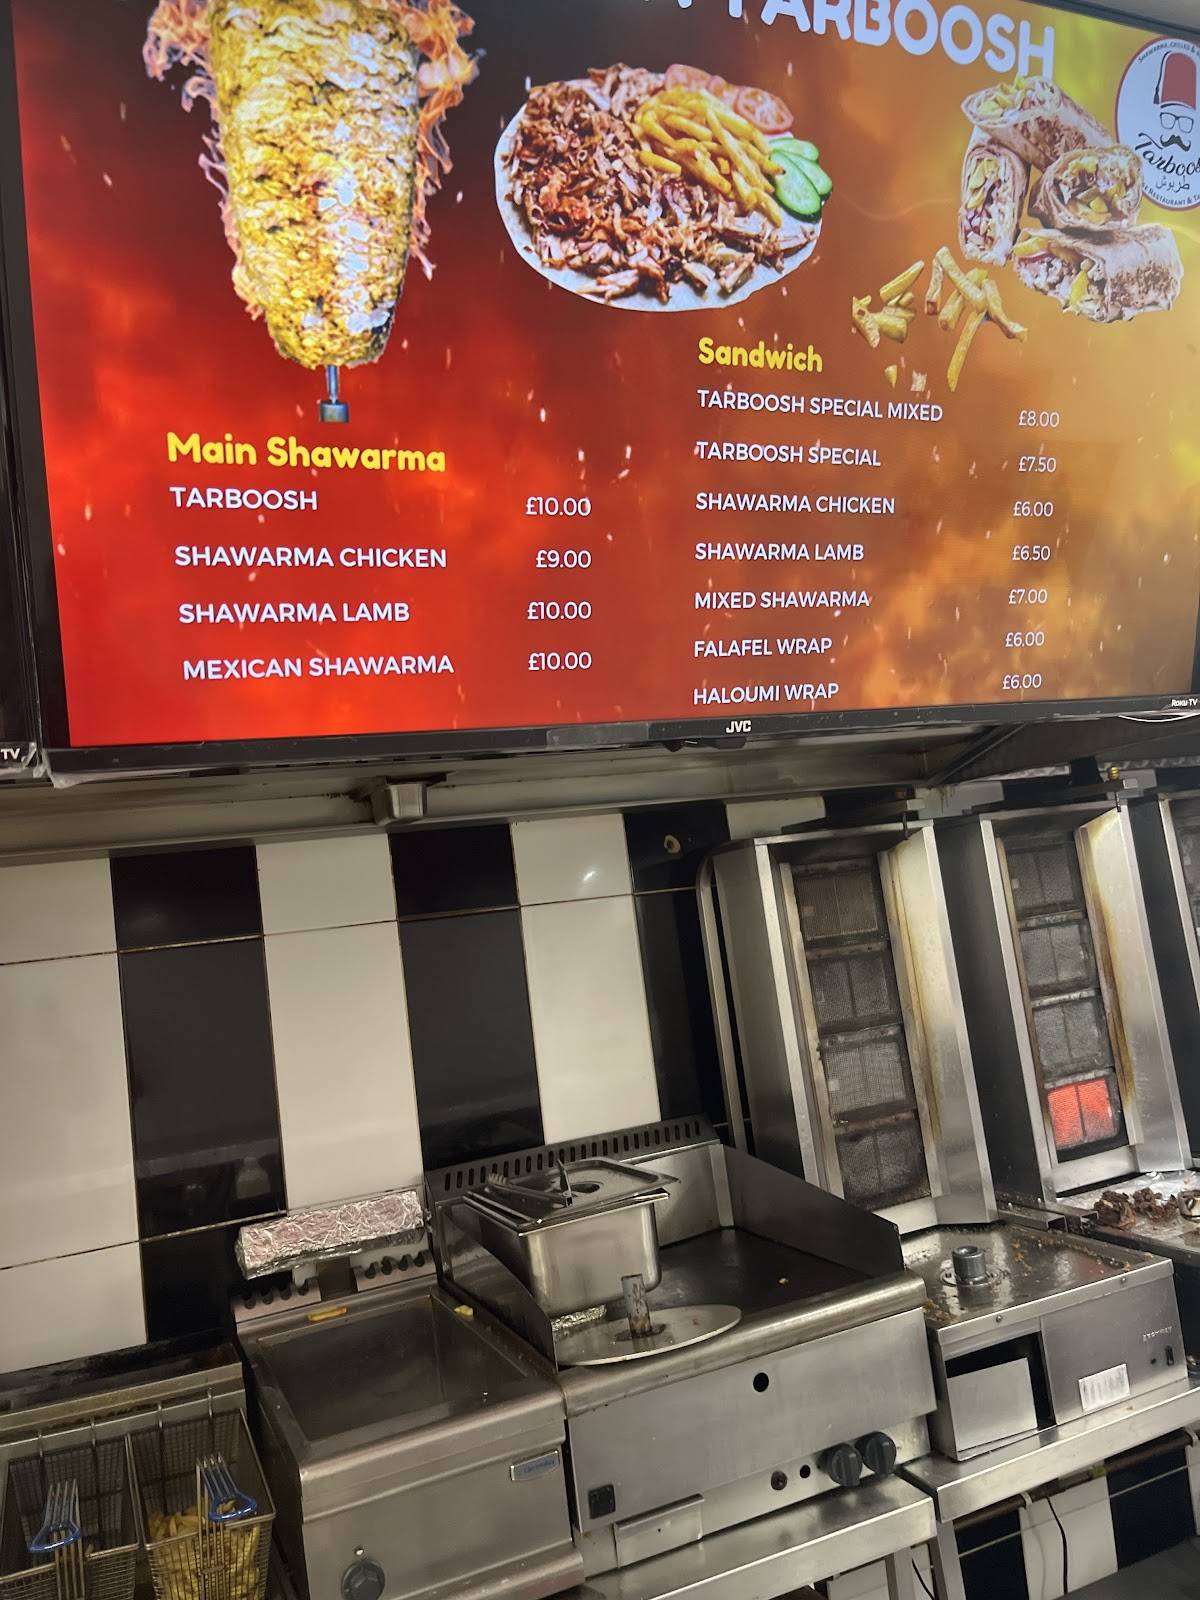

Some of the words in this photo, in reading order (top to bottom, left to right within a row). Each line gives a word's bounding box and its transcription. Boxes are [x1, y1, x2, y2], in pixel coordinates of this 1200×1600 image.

[698, 337, 823, 373] Sandwich
[697, 389, 805, 414] TARBOOSH
[809, 396, 883, 418] SPECIAL
[888, 402, 943, 421] MIXED
[1018, 410, 1060, 428] £8.00
[167, 431, 257, 465] Main
[267, 436, 446, 472] Shawarma
[696, 442, 803, 463] TARBOOSH
[808, 446, 881, 466] SPECIAL
[1018, 455, 1057, 473] £7.50
[169, 486, 317, 511] TARBOOSH
[525, 496, 592, 517] £10.00
[695, 493, 811, 513] SHAWARMA
[816, 496, 895, 514] CHICKEN
[1013, 501, 1054, 517] £6.00
[175, 545, 334, 567] SHAWARMA
[339, 547, 447, 568] CHICKEN
[535, 549, 592, 569] £9.00
[695, 543, 809, 561] SHAWARMA
[814, 543, 865, 561] LAMB
[1012, 545, 1051, 561] £6.50
[695, 592, 756, 609] MIXED
[760, 591, 870, 608] SHAWARMA
[1008, 588, 1048, 605] £7.00
[179, 602, 336, 624] SHAWARMA
[342, 602, 410, 622] LAMB
[527, 601, 592, 620] £10.00
[694, 639, 773, 657] FALAFEL
[777, 637, 832, 655] WRAP
[1005, 631, 1045, 648] £6.00
[183, 658, 302, 681] MEXICAN
[309, 655, 454, 677] SHAWARMA
[528, 651, 592, 671] £10.00
[1002, 673, 1042, 690] £6.00
[693, 685, 780, 705] HALOUMI
[784, 683, 839, 701] WRAP
[1188, 698, 1198, 706] TV
[725, 720, 751, 733] JVC
[0, 748, 20, 760] TV
